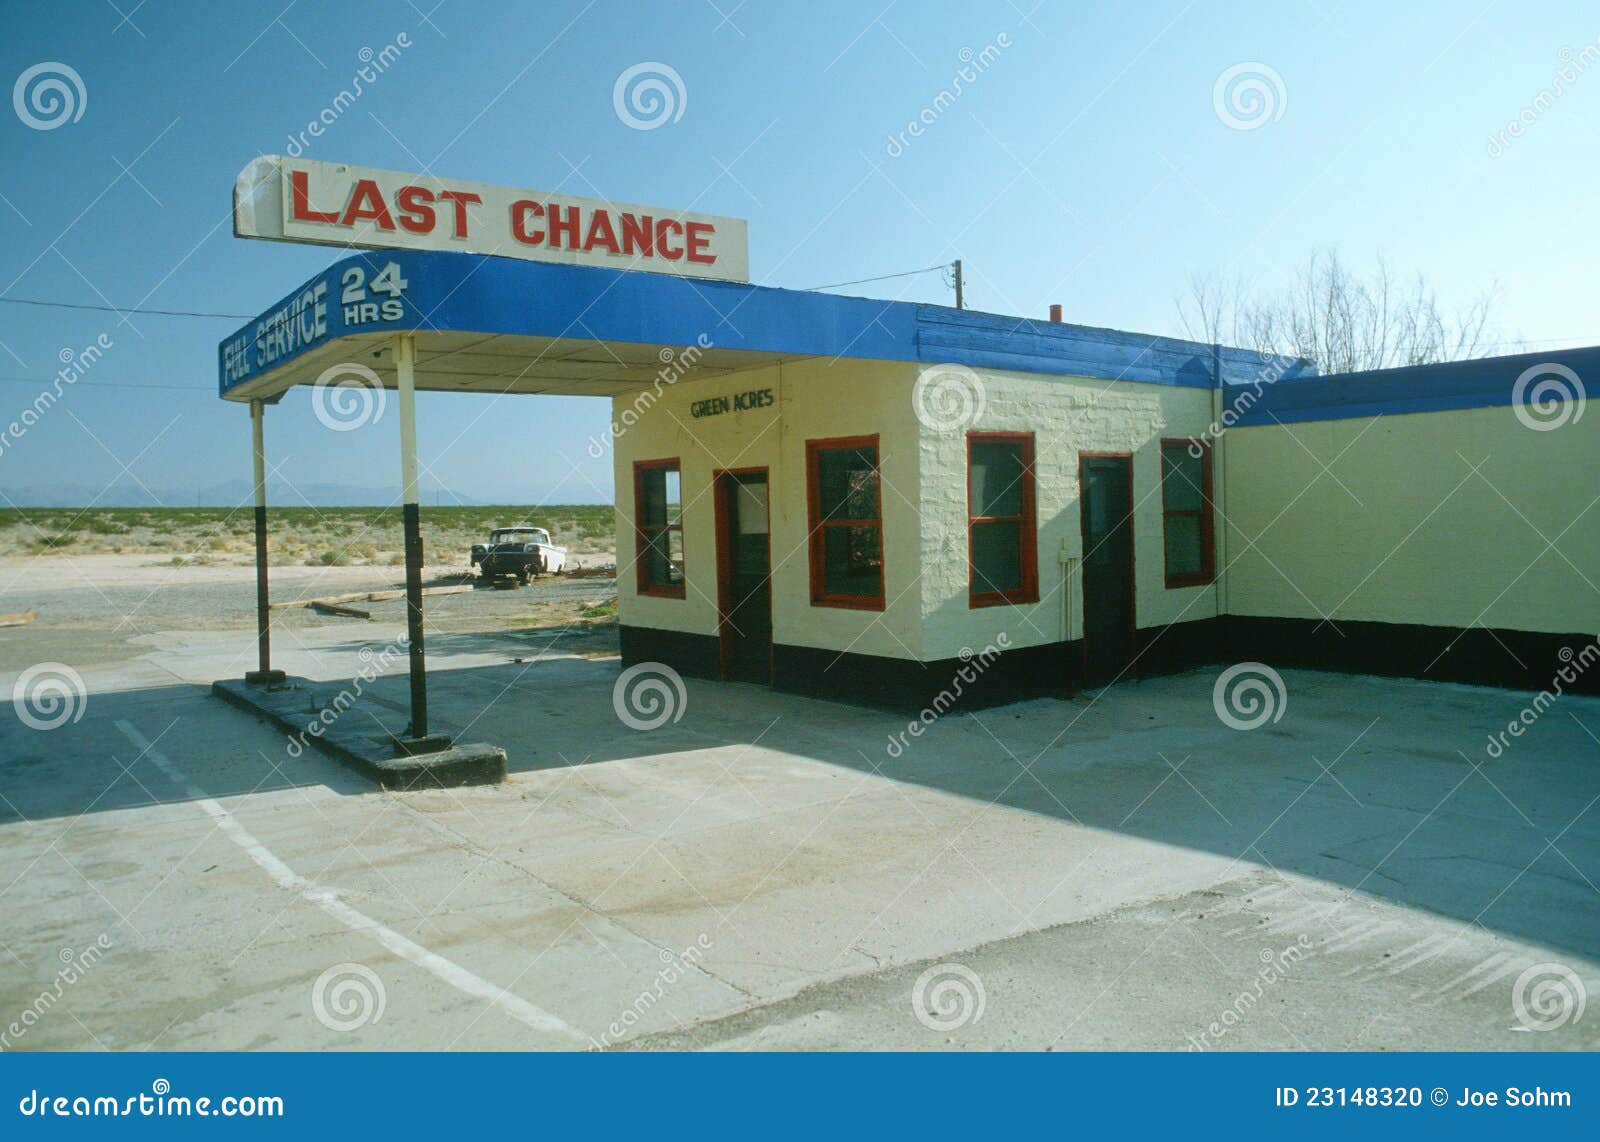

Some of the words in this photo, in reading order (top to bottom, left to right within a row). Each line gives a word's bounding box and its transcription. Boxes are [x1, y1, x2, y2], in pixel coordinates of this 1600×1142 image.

[291, 170, 482, 239] LAST
[511, 199, 718, 265] CHANCE
[341, 261, 408, 304] 24
[224, 335, 251, 386] FULL
[256, 281, 328, 368] SERVICE
[343, 300, 405, 327] HRS
[690, 396, 729, 418] GREEN
[733, 388, 774, 412] ACRES
